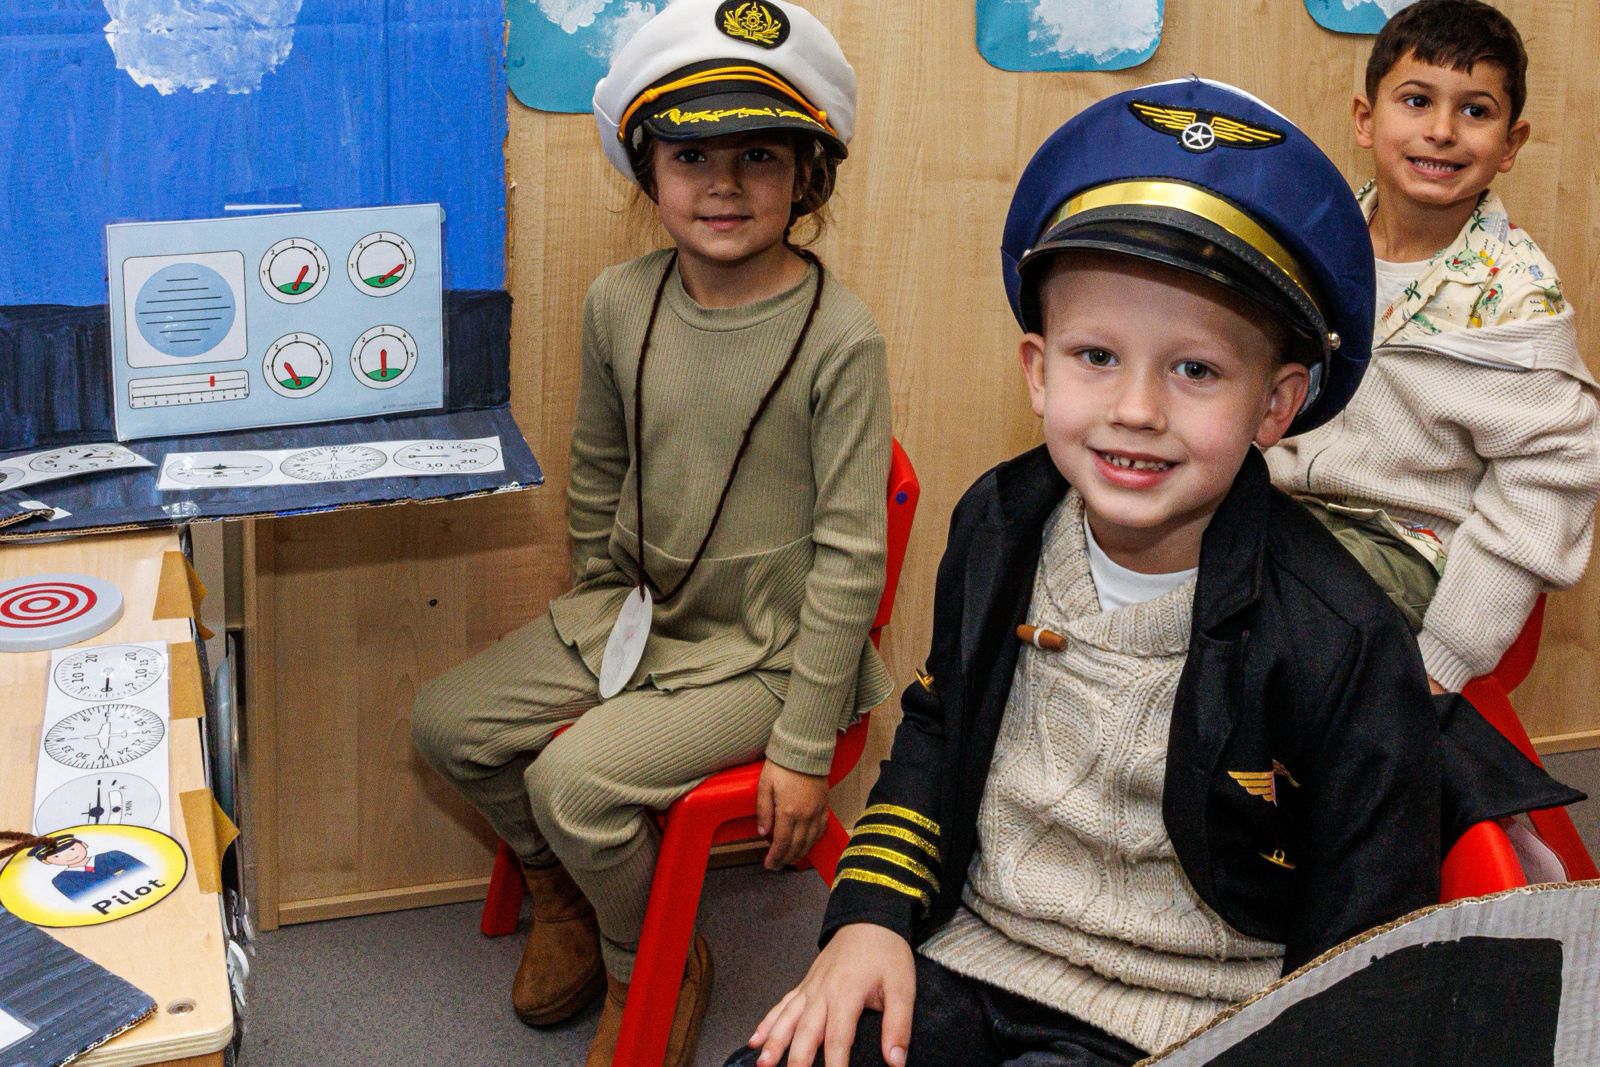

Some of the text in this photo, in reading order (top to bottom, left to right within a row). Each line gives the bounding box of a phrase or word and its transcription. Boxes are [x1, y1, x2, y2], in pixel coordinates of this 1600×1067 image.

[85, 654, 98, 663] 20
[125, 652, 137, 661] 20
[72, 672, 84, 683] 10
[135, 669, 147, 678] 10
[91, 878, 166, 916] Pilot
